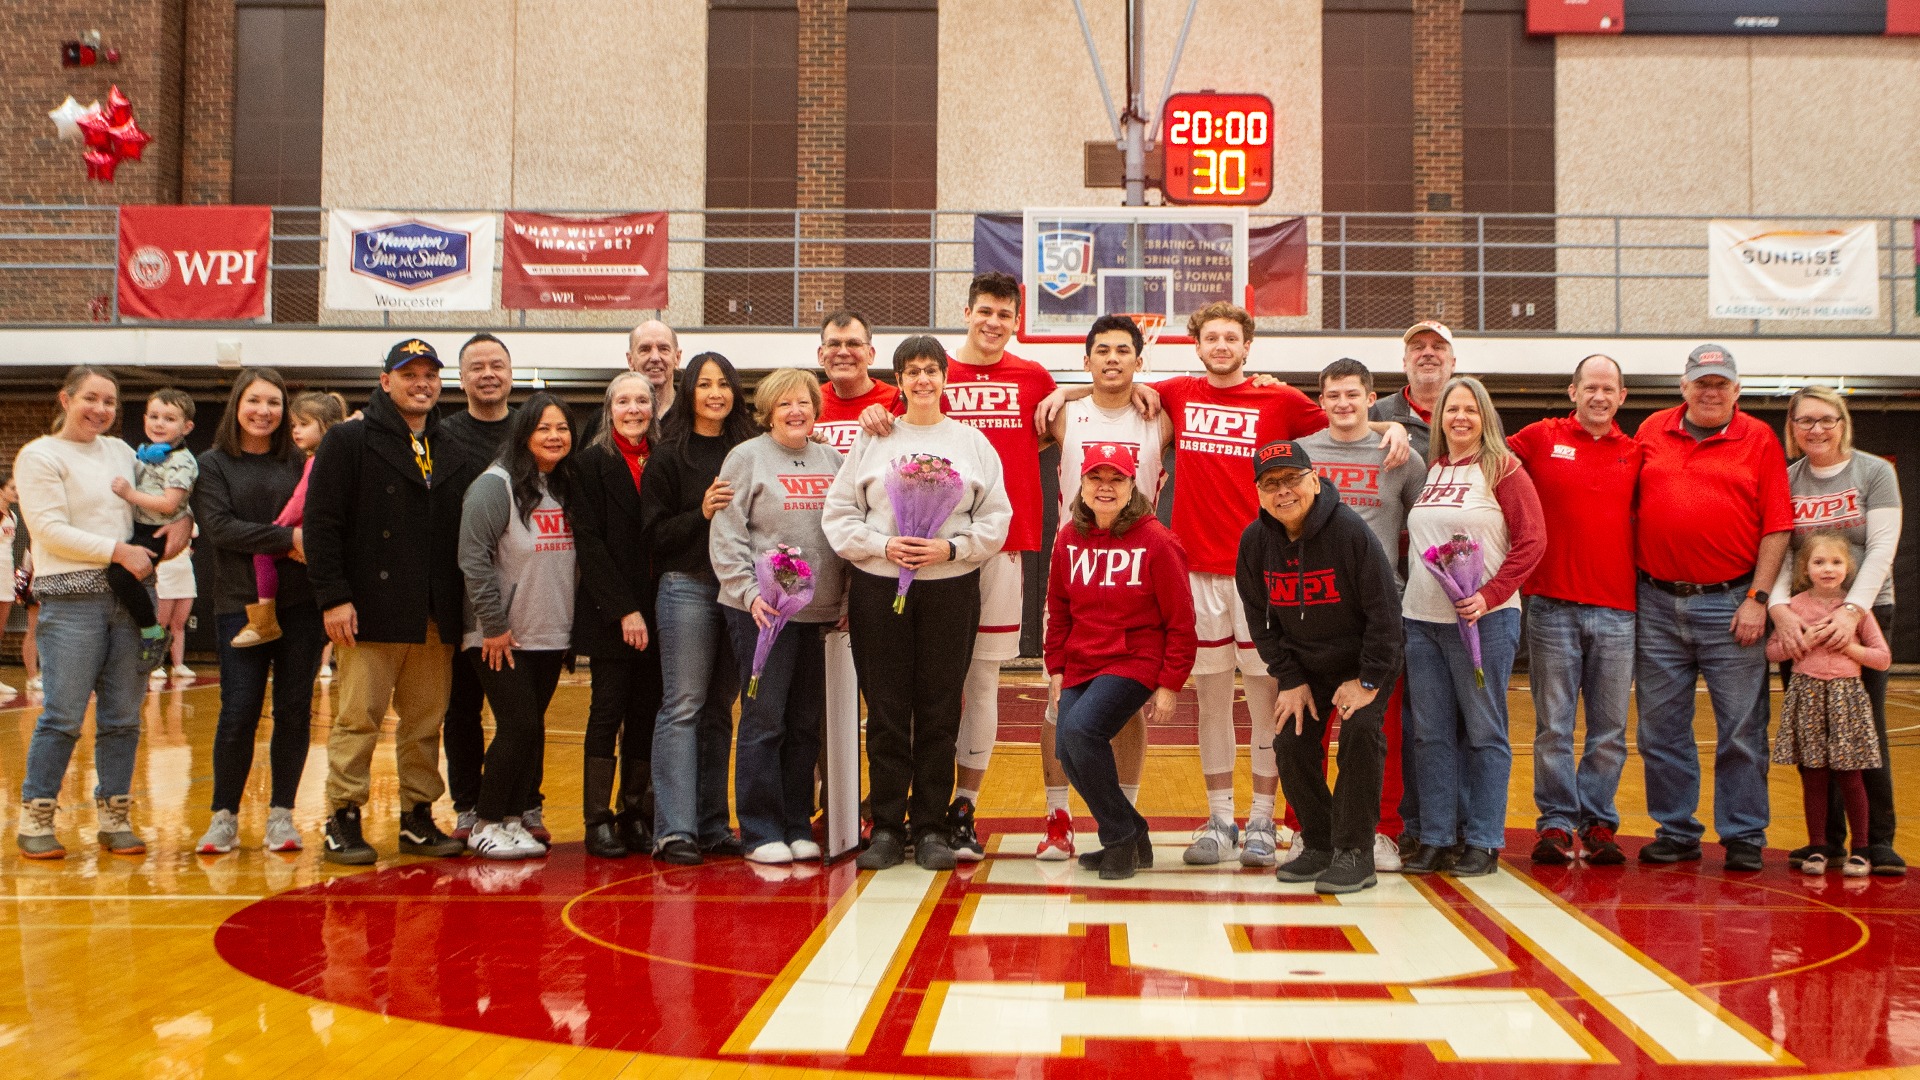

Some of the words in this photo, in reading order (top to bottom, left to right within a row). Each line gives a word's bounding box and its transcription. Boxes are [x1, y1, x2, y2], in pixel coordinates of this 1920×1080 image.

[1171, 111, 1268, 145] 20:00
[1193, 150, 1246, 195] 30
[514, 223, 560, 238] WHAT
[568, 227, 606, 239] WILL
[614, 223, 656, 237] YOUR
[367, 232, 449, 251] Hampton
[535, 238, 597, 251] IMPACT
[603, 238, 633, 251] BE?
[1199, 240, 1216, 251] THE
[364, 250, 403, 269] Inn
[413, 249, 457, 268] Suites
[1045, 246, 1083, 272] 50
[1183, 255, 1202, 266] THE
[1742, 250, 1841, 266] SUNRISE
[173, 250, 258, 286] WPI
[386, 270, 397, 279] by
[399, 270, 434, 279] HILTON
[1186, 271, 1233, 282] FORWAR
[375, 294, 444, 308] Worcester
[551, 291, 575, 303] WPI
[1715, 304, 1774, 316] CAREERS
[1778, 304, 1811, 316] WITH
[1813, 304, 1873, 316] MEANING
[944, 387, 1020, 411] WPI
[954, 418, 1023, 429] SKETBALL
[1184, 407, 1260, 439] WPI
[813, 426, 862, 446] WP
[1259, 444, 1293, 462] WPI
[779, 478, 835, 495] WP
[1415, 487, 1470, 504] WPI
[783, 502, 825, 511] BASKET
[1790, 494, 1858, 520] WPI
[535, 542, 573, 553] BASKET
[1067, 545, 1147, 587] WPI
[1264, 574, 1340, 601] WPI
